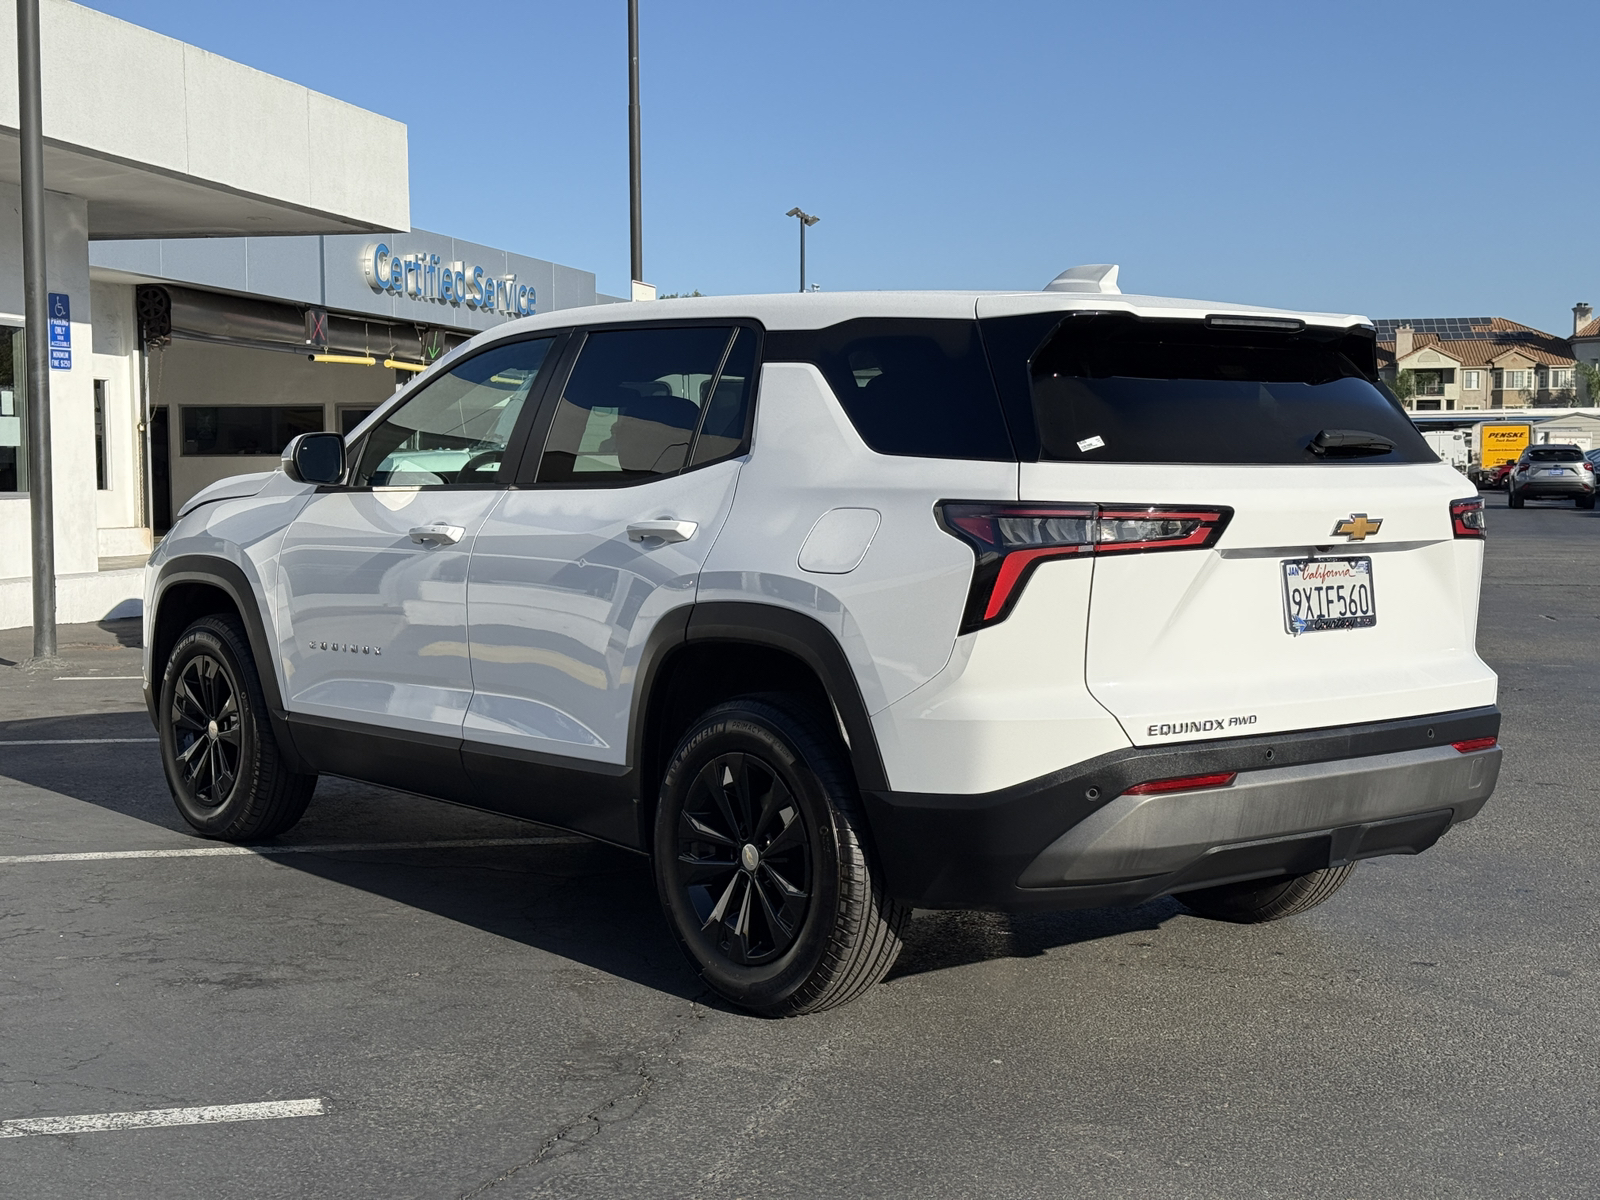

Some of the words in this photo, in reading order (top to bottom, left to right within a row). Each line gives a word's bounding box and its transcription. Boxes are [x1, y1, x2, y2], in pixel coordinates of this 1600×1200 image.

[371, 242, 466, 303] Certified
[472, 265, 537, 315] Service
[50, 318, 69, 326] PARKING
[54, 326, 66, 335] ONLY
[51, 359, 60, 367] FINE
[60, 360, 71, 368] $250
[1288, 566, 1299, 577] JAN
[1301, 563, 1356, 585] California
[1292, 583, 1369, 619] 9XIF560
[1314, 616, 1356, 631] Courtesy
[308, 641, 382, 656] EQUINOX
[1147, 719, 1225, 736] EQUINOX
[1228, 714, 1257, 727] AWD
[680, 722, 725, 760] MICHELIN
[732, 720, 761, 735] PRIMACY
[772, 739, 790, 758] SEASON
